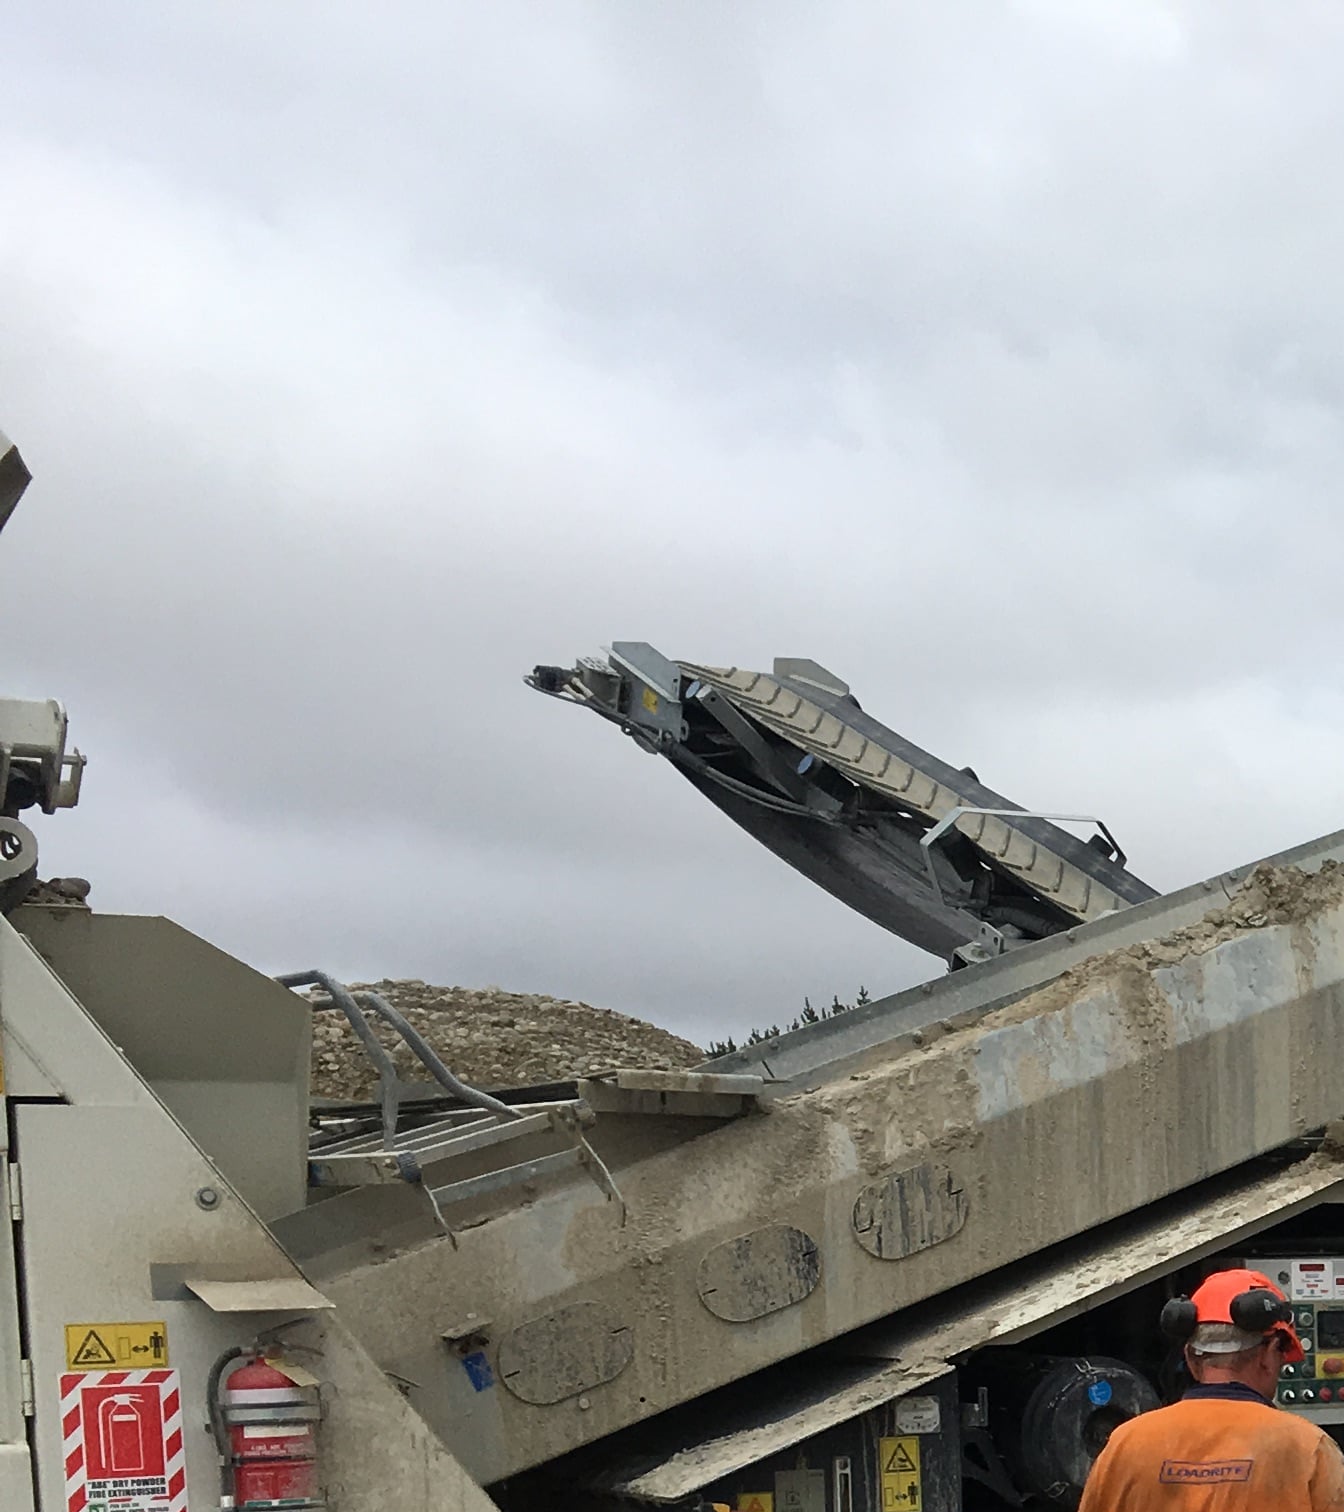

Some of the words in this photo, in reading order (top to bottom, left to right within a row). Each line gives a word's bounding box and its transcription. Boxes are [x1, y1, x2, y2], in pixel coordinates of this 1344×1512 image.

[131, 1478, 166, 1486] POWDER
[88, 1490, 107, 1498] FIRE
[108, 1487, 166, 1497] EXTINGUISHER
